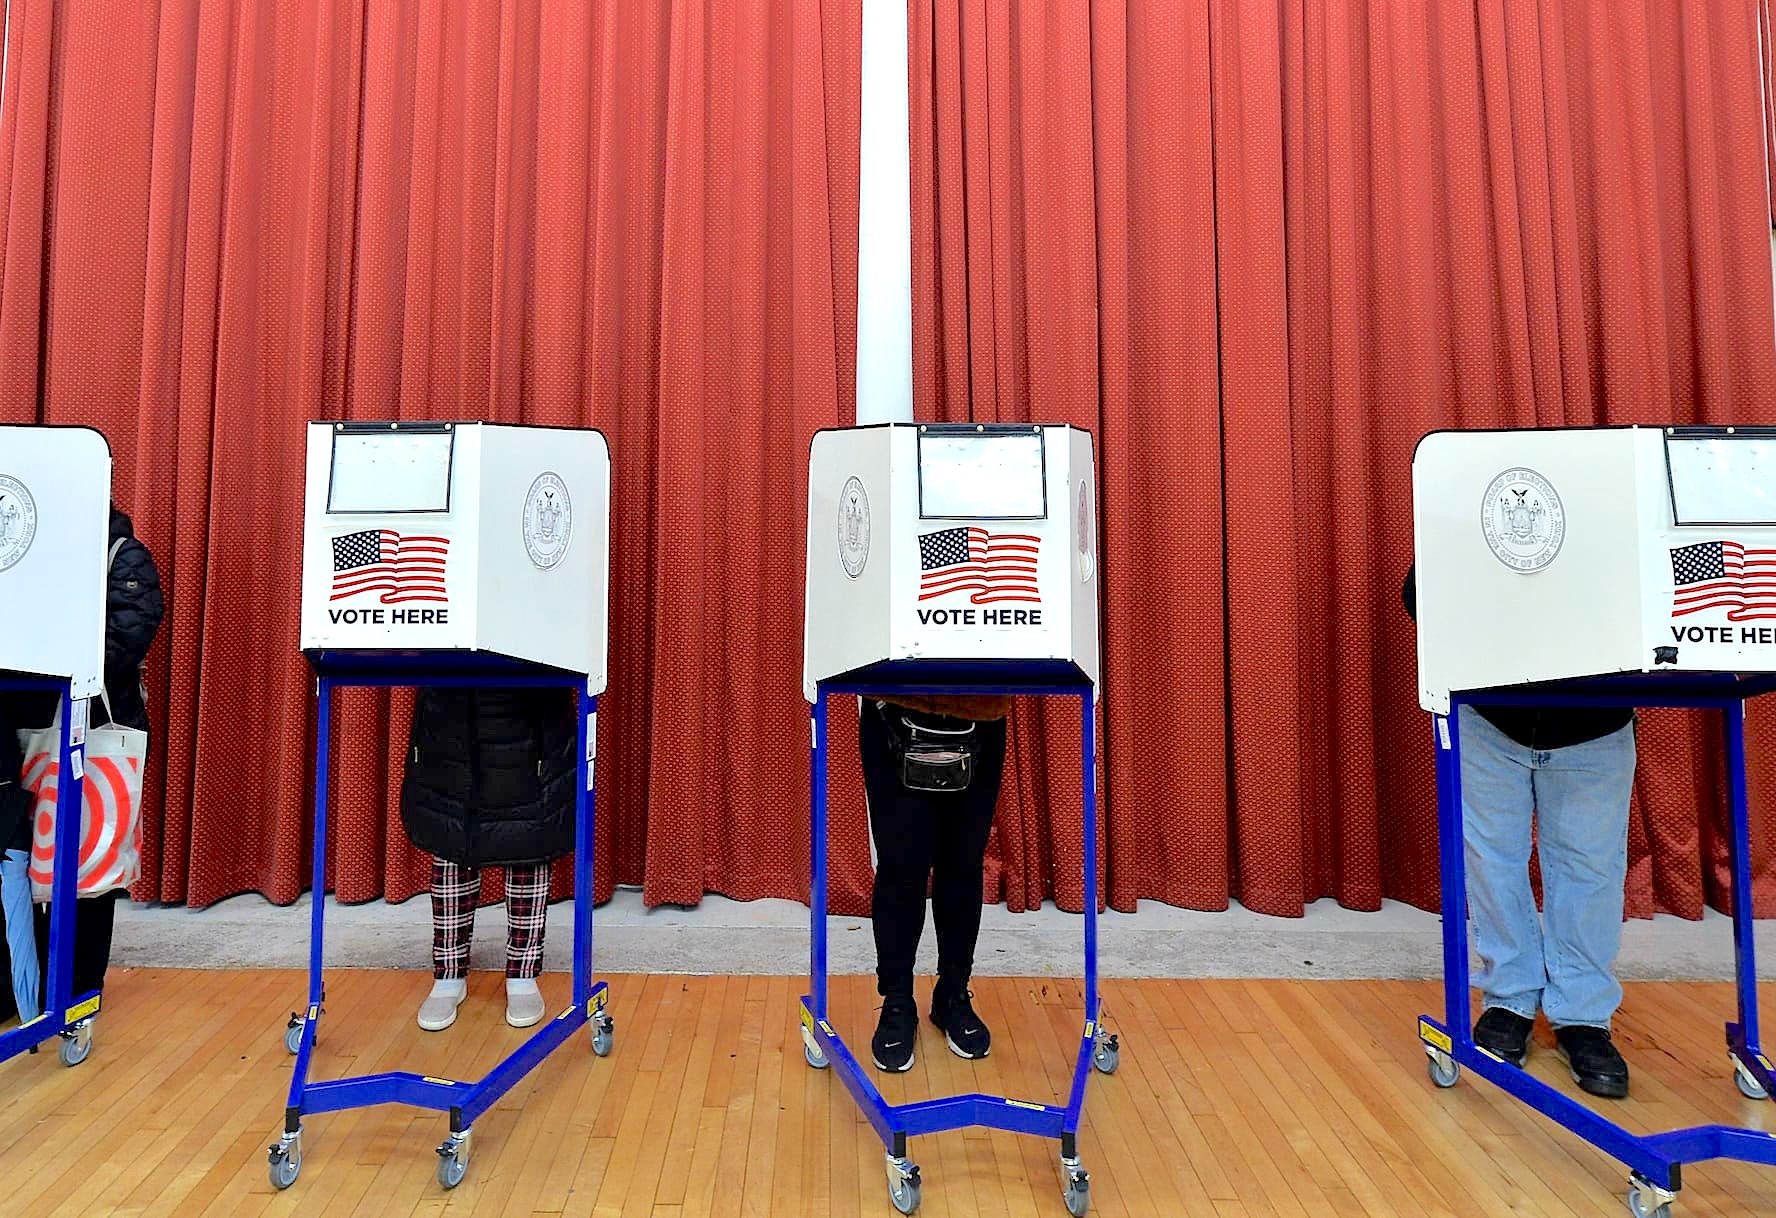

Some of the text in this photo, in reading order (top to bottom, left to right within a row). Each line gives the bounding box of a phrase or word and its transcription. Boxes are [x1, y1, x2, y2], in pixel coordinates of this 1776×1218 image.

[328, 610, 448, 625] VOTE HERE
[917, 610, 1041, 625] VOTE HERE
[1671, 626, 1776, 644] VOTE HE
